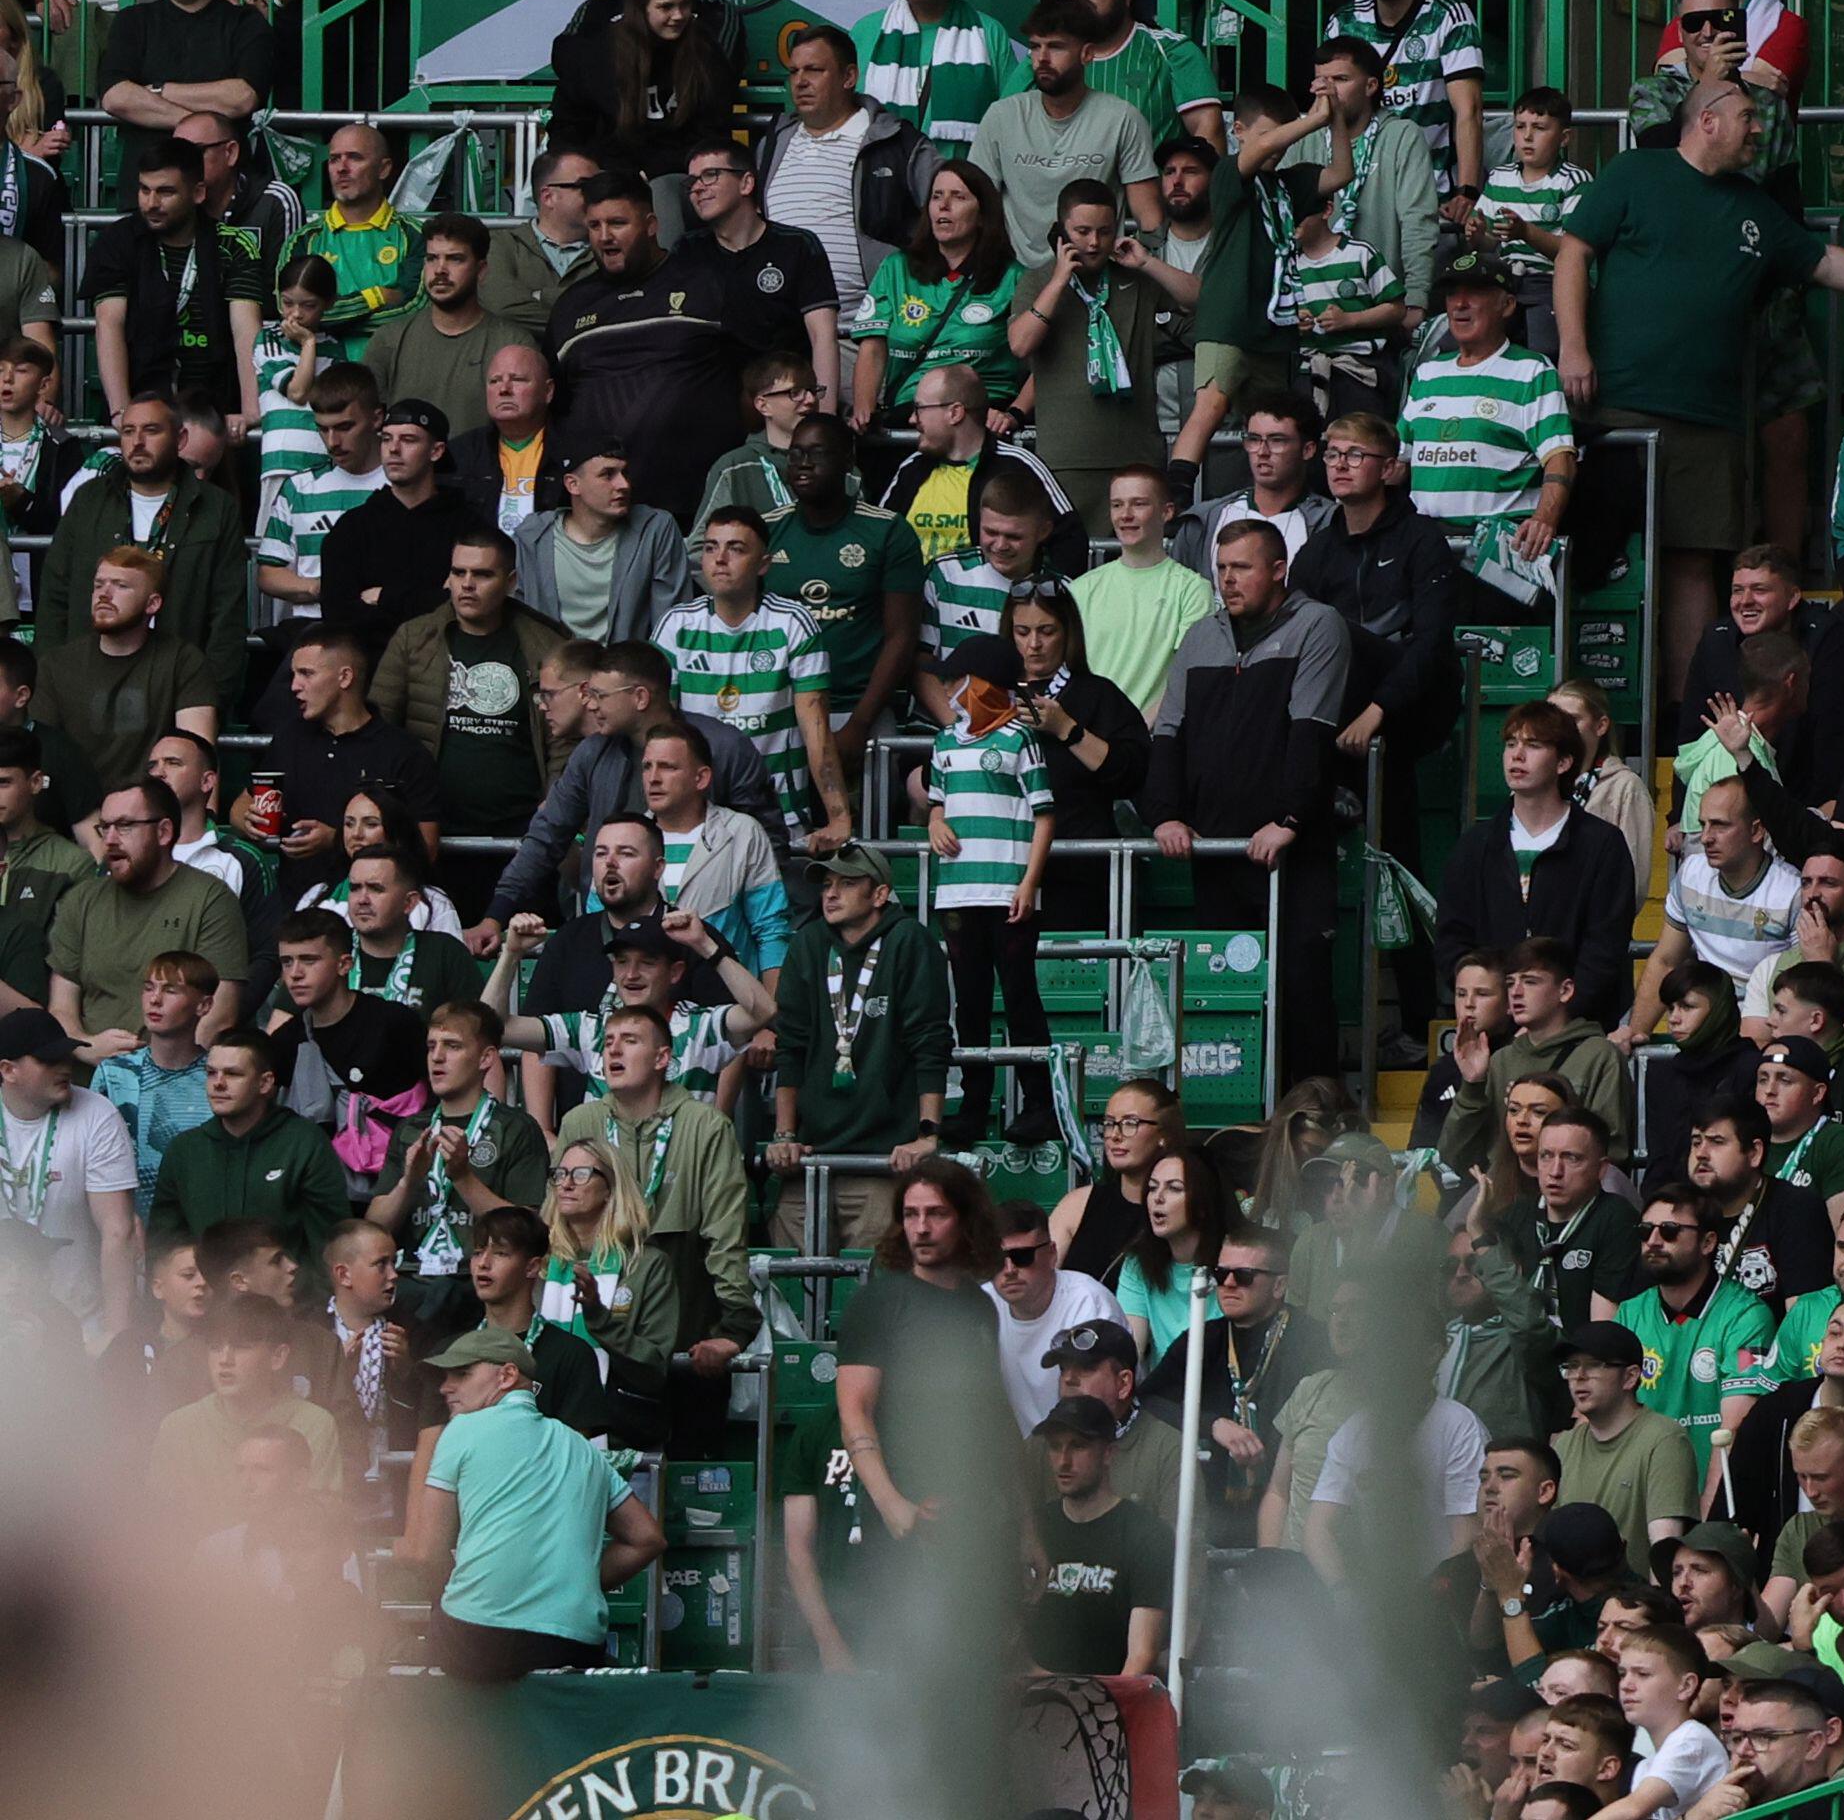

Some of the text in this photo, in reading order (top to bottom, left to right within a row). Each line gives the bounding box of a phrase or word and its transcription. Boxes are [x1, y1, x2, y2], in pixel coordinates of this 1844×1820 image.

[1014, 154, 1105, 169] NIKE PRO
[1418, 446, 1477, 464] dafabet
[914, 513, 968, 528] CR SMI
[808, 606, 858, 621] abet
[449, 715, 482, 726] EVERY
[411, 1207, 474, 1227] dbet
